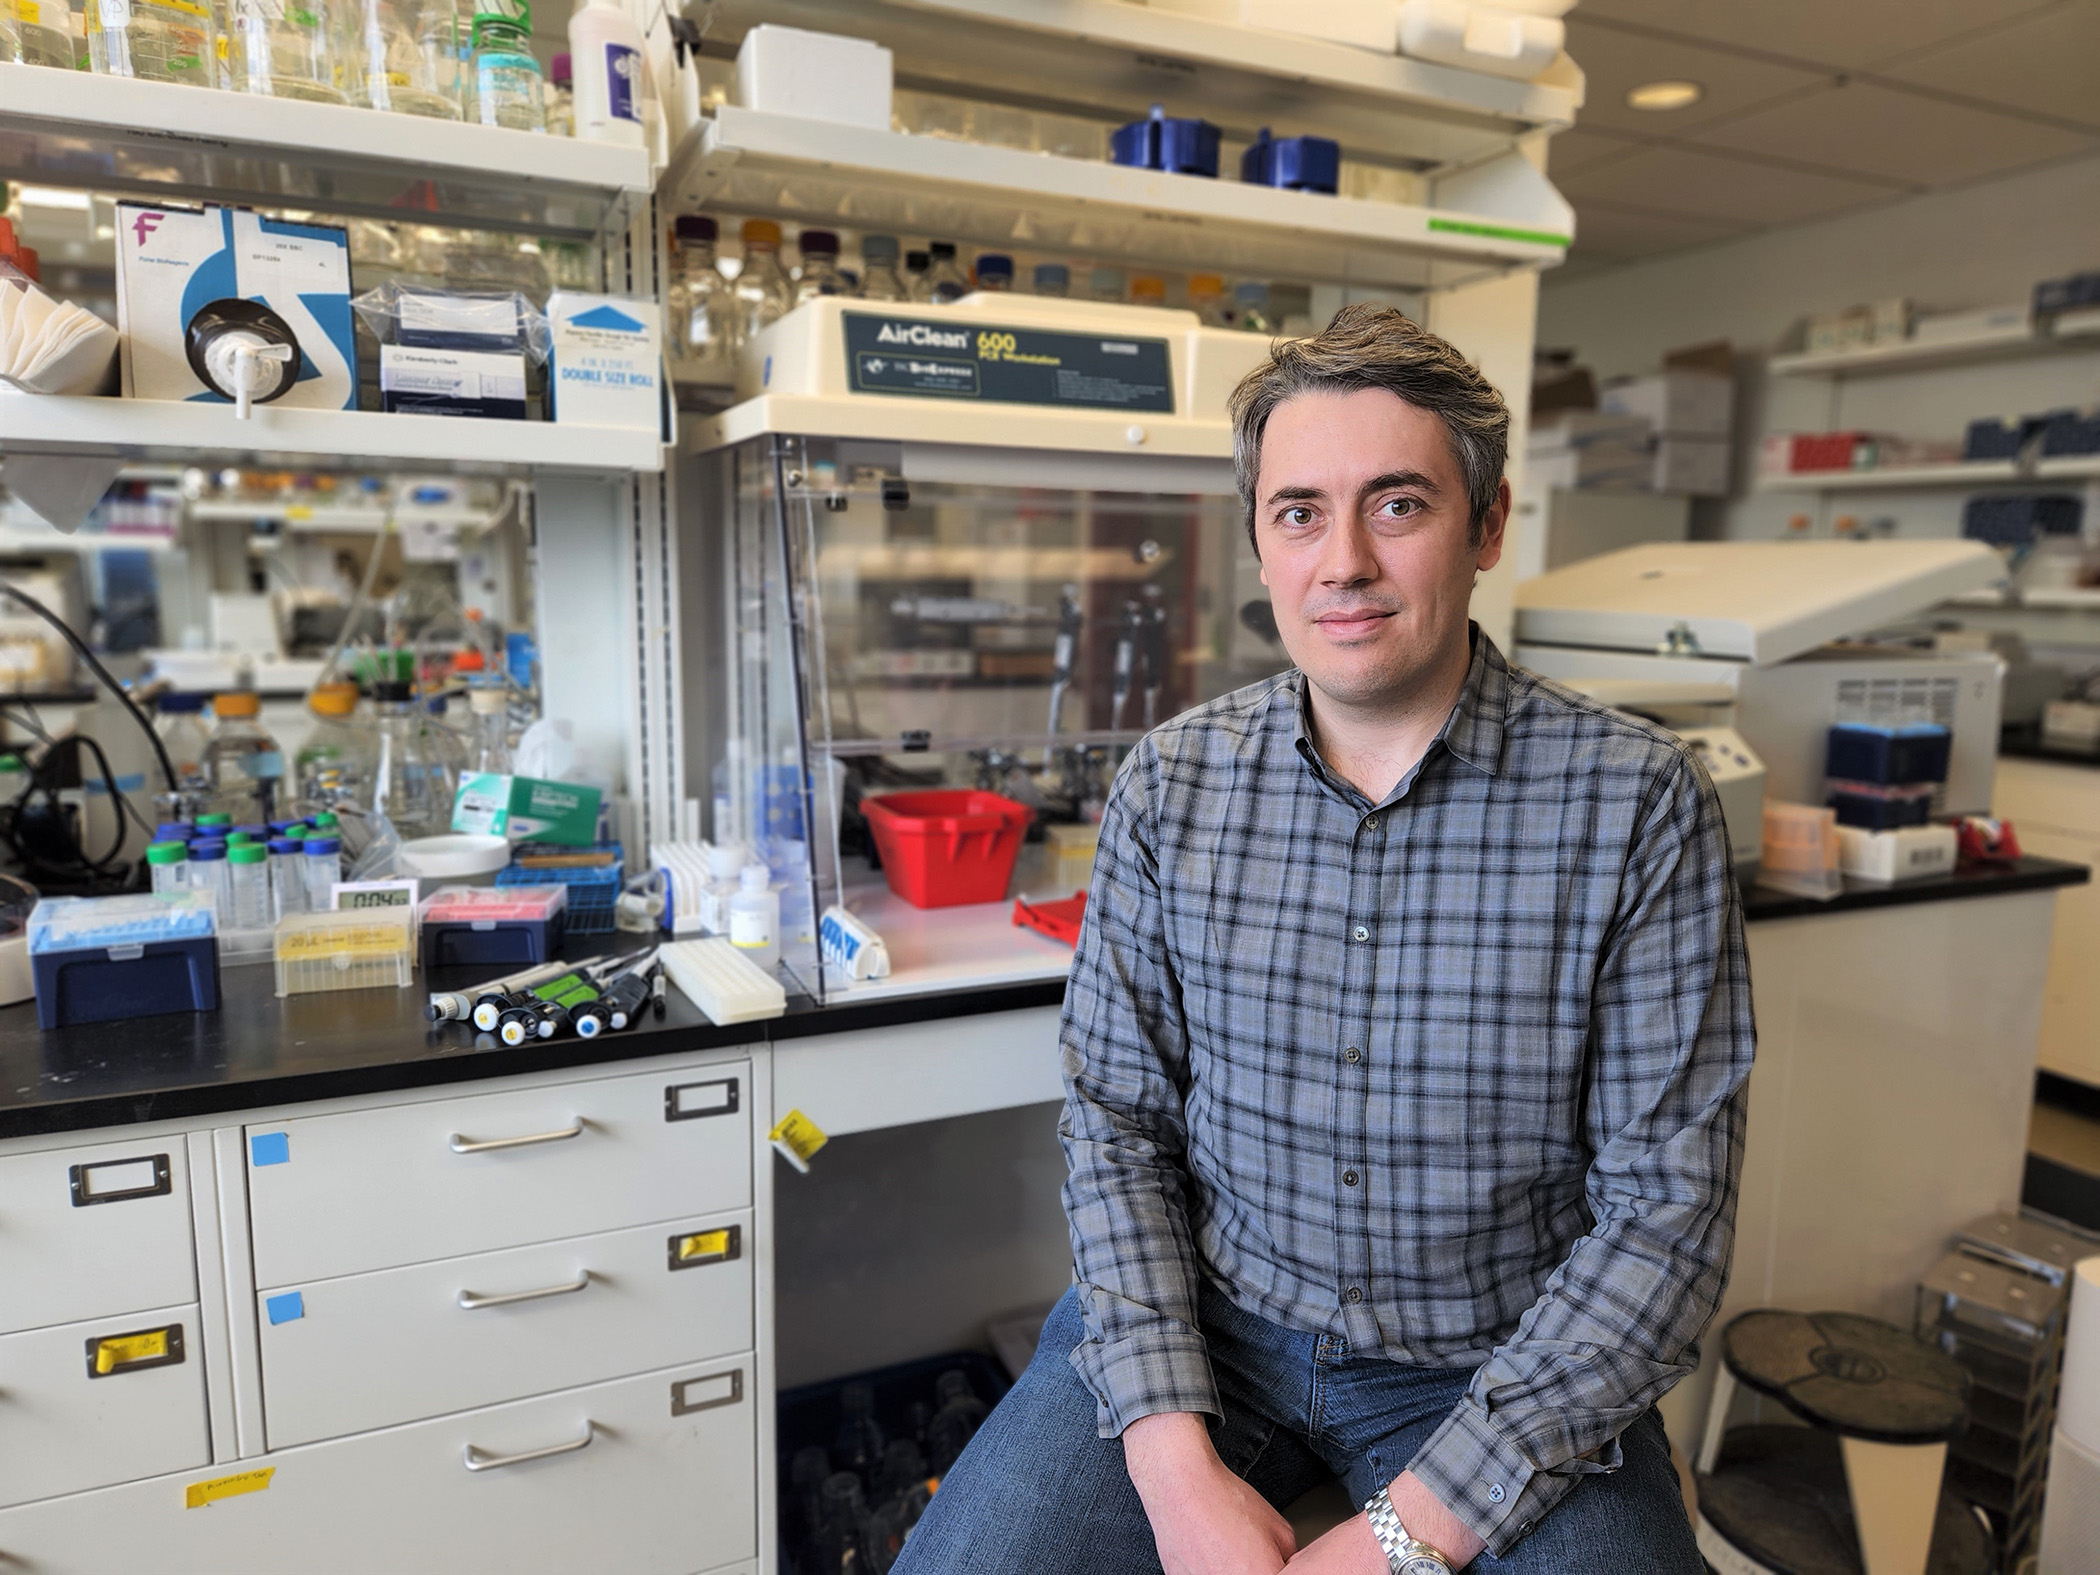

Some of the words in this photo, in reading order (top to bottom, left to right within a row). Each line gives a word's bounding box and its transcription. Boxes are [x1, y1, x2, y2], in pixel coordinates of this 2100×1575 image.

[877, 323, 968, 348] AirClean
[977, 331, 1017, 352] 600
[561, 366, 601, 382] DOUBLE
[604, 370, 626, 385] SIZE
